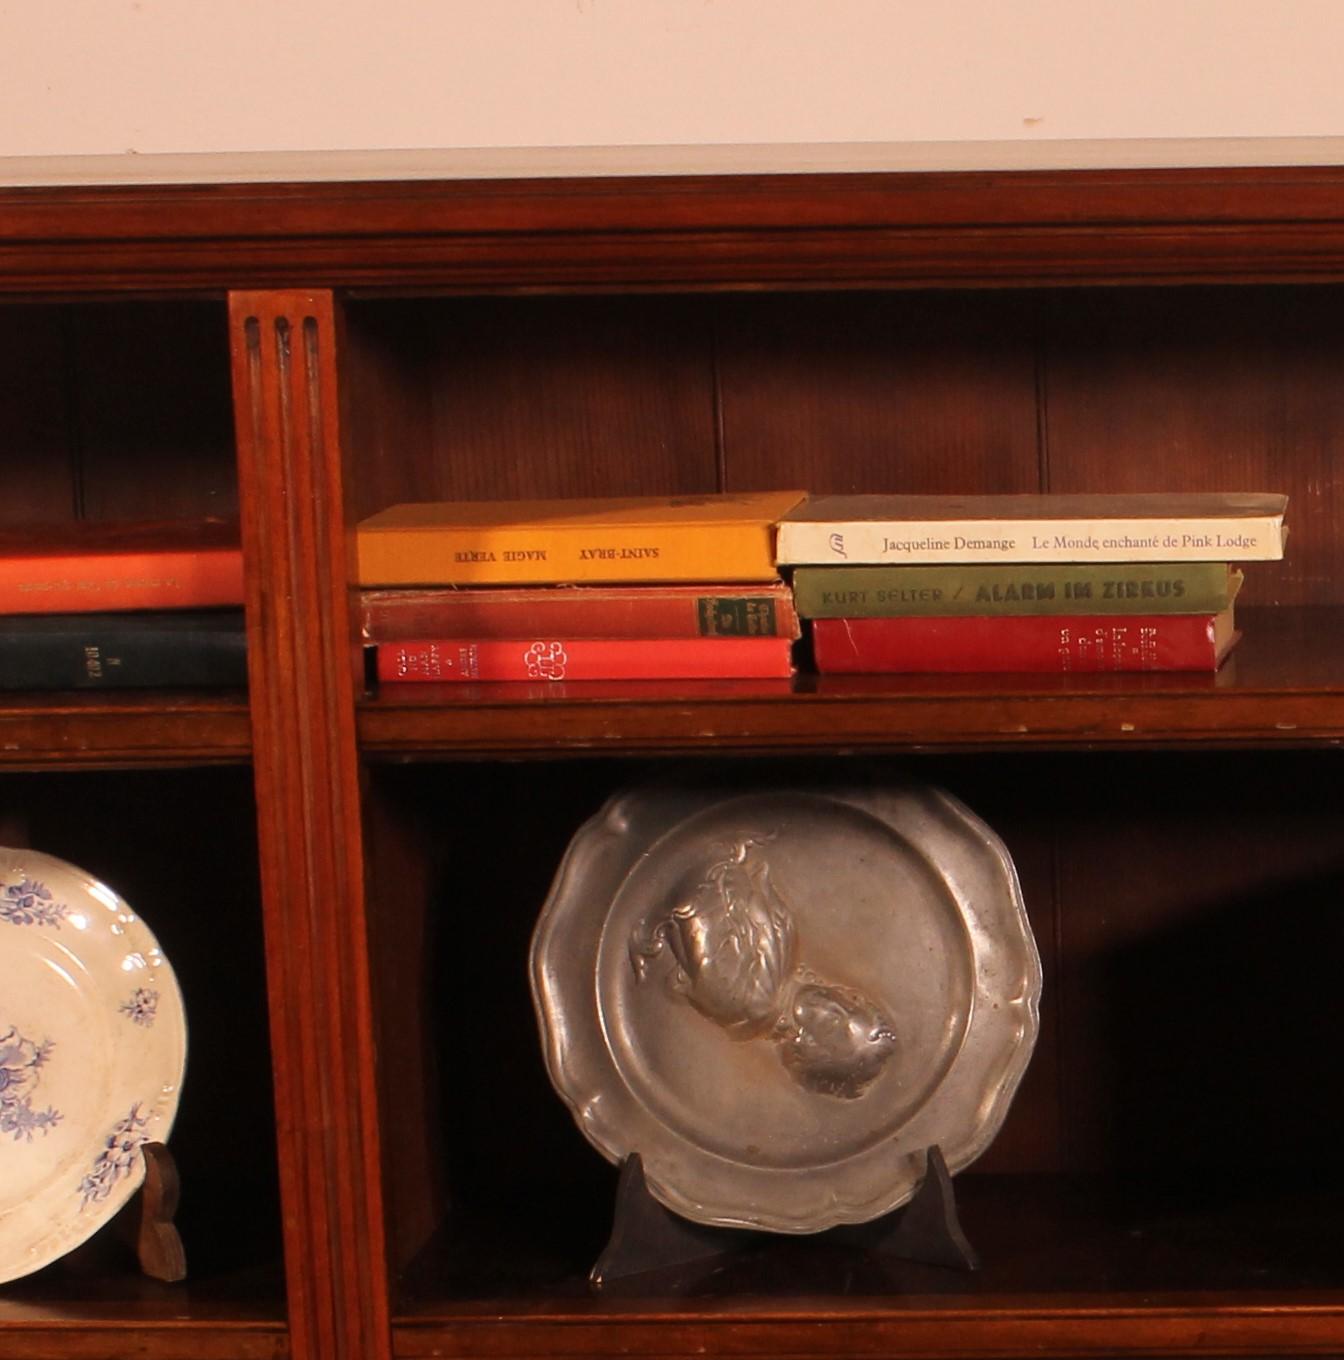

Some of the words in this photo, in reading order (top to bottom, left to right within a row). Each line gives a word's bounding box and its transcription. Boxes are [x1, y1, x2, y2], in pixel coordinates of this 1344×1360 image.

[883, 537, 950, 553] Jacqueline
[954, 536, 1016, 552] Demange
[1032, 536, 1050, 549] Le
[1054, 535, 1099, 550] Monde
[1103, 535, 1159, 548] enchanté
[1162, 535, 1178, 548] de
[1181, 534, 1212, 548] Pink
[1216, 534, 1257, 549] Lodge
[455, 551, 496, 562] VERTE
[503, 550, 547, 561] MAGIE
[579, 547, 659, 560] SAINT-BRAY
[822, 591, 866, 604] KURT
[976, 582, 1055, 602] ALARM
